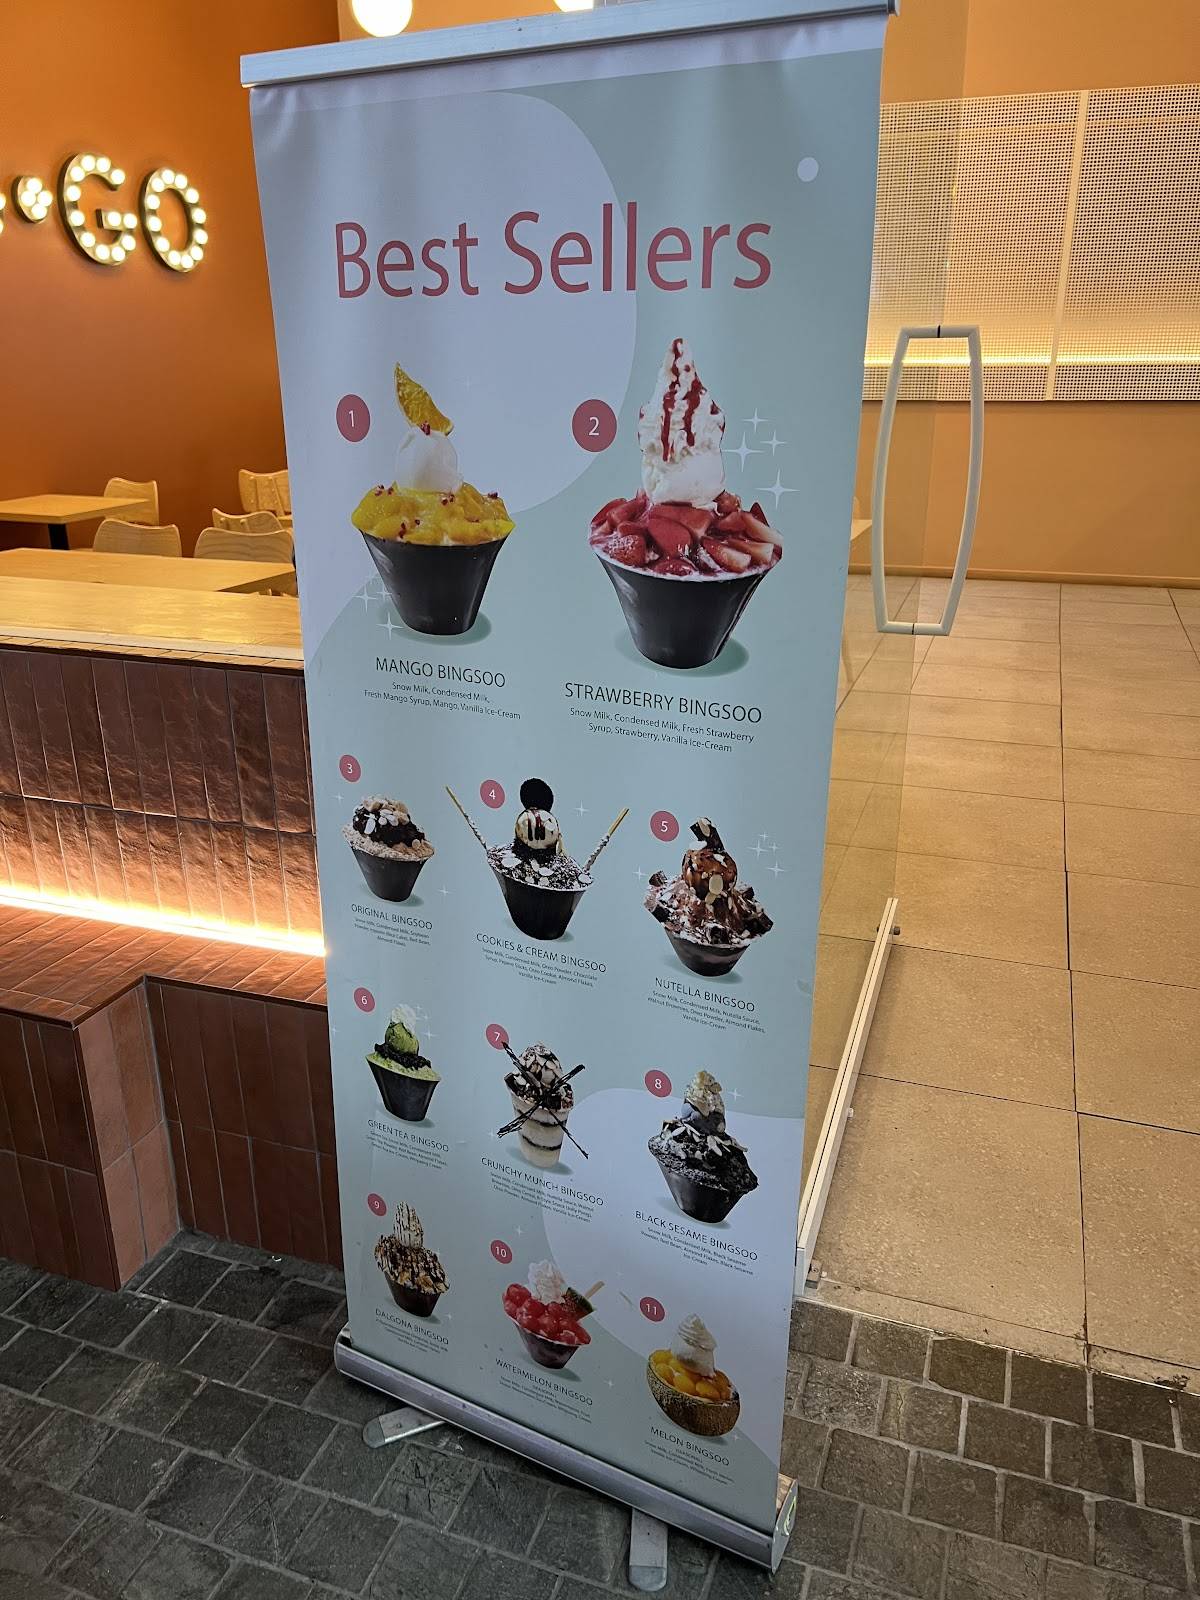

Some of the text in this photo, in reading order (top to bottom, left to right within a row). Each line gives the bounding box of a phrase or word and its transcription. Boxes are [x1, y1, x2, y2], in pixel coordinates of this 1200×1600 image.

[57, 153, 208, 272] GO
[335, 202, 772, 298] Best Sellers
[348, 410, 355, 428] 1
[588, 416, 600, 436] 2
[376, 657, 506, 687] MANGO BINGSOO
[364, 690, 521, 720] Fresh Mango Syrup, Mango, Vanilla Ice-Cream
[392, 682, 490, 703] Snow Milk, Condensed Milk,
[565, 682, 762, 724] STRAWBERRY BINGSOO
[570, 708, 754, 744] Snow Milk, Condensed Milk, Fresh Strawberry
[588, 723, 732, 752] Syrup, Strawberry, Vanilla Ice-Cream
[347, 763, 353, 774] 3
[489, 789, 496, 800] 4
[660, 820, 668, 833] 5
[351, 904, 389, 921] ORIGINAL
[392, 913, 433, 930] BINGSOO
[476, 933, 606, 973] COOKIES & CREAM BINGSOO
[361, 995, 368, 1005] 6
[655, 977, 755, 1012] NUTELLA BINGSOO
[680, 998, 709, 1011] Condensed
[494, 1031, 501, 1042] 7
[654, 1078, 662, 1090] 8
[368, 1119, 393, 1134] GREEN
[394, 1128, 409, 1140] TEA
[410, 1134, 449, 1152] BINGSOO
[481, 1157, 604, 1206] CRUNCHY MUNCH BINGSOO
[374, 1201, 380, 1209] 9
[635, 1210, 758, 1261] BLACK SESAME BINGSOO
[495, 1246, 507, 1258] 10
[646, 1303, 657, 1315] 11
[375, 1308, 413, 1329] DALGONA
[414, 1324, 449, 1345] BINGSOO
[495, 1358, 552, 1389] WATERMELON
[553, 1383, 593, 1406] BINGSOO
[650, 1426, 684, 1446] MELON
[685, 1441, 730, 1466] BINGSOO
